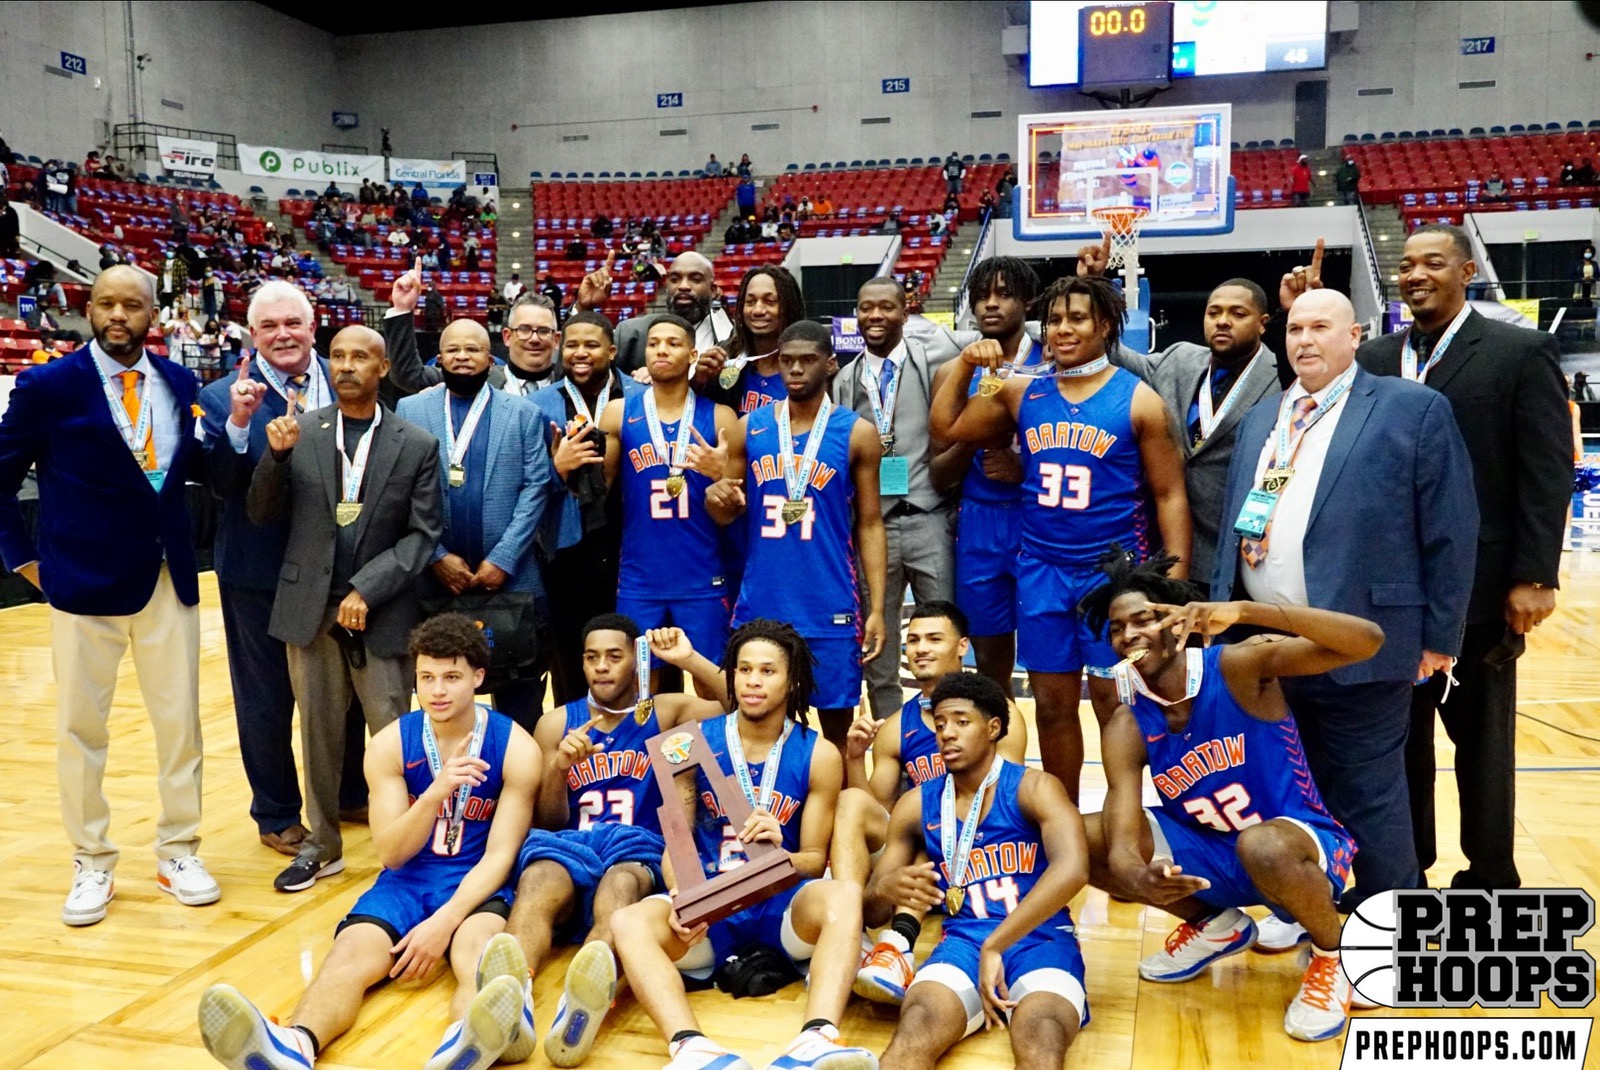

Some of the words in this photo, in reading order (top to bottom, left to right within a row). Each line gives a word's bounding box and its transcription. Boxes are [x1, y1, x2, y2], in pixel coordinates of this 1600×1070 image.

[1090, 8, 1146, 36] 00.0
[64, 55, 83, 72] 212
[1465, 39, 1491, 53] 217
[659, 95, 680, 107] 214
[885, 80, 906, 92] 215
[293, 157, 360, 177] Publix
[395, 167, 427, 179] Central
[428, 168, 461, 179] Florida
[20, 303, 34, 313] 110
[835, 336, 865, 345] BOND
[1024, 420, 1118, 459] BARTOW
[649, 479, 690, 520] 21
[1037, 461, 1092, 511] 33
[760, 494, 816, 541] 34
[567, 749, 652, 792] BARTOW
[905, 752, 947, 787] BAR
[1152, 732, 1246, 800] BARTOW
[578, 788, 634, 832] 23
[1182, 781, 1264, 833] 32
[966, 875, 1020, 920] 14
